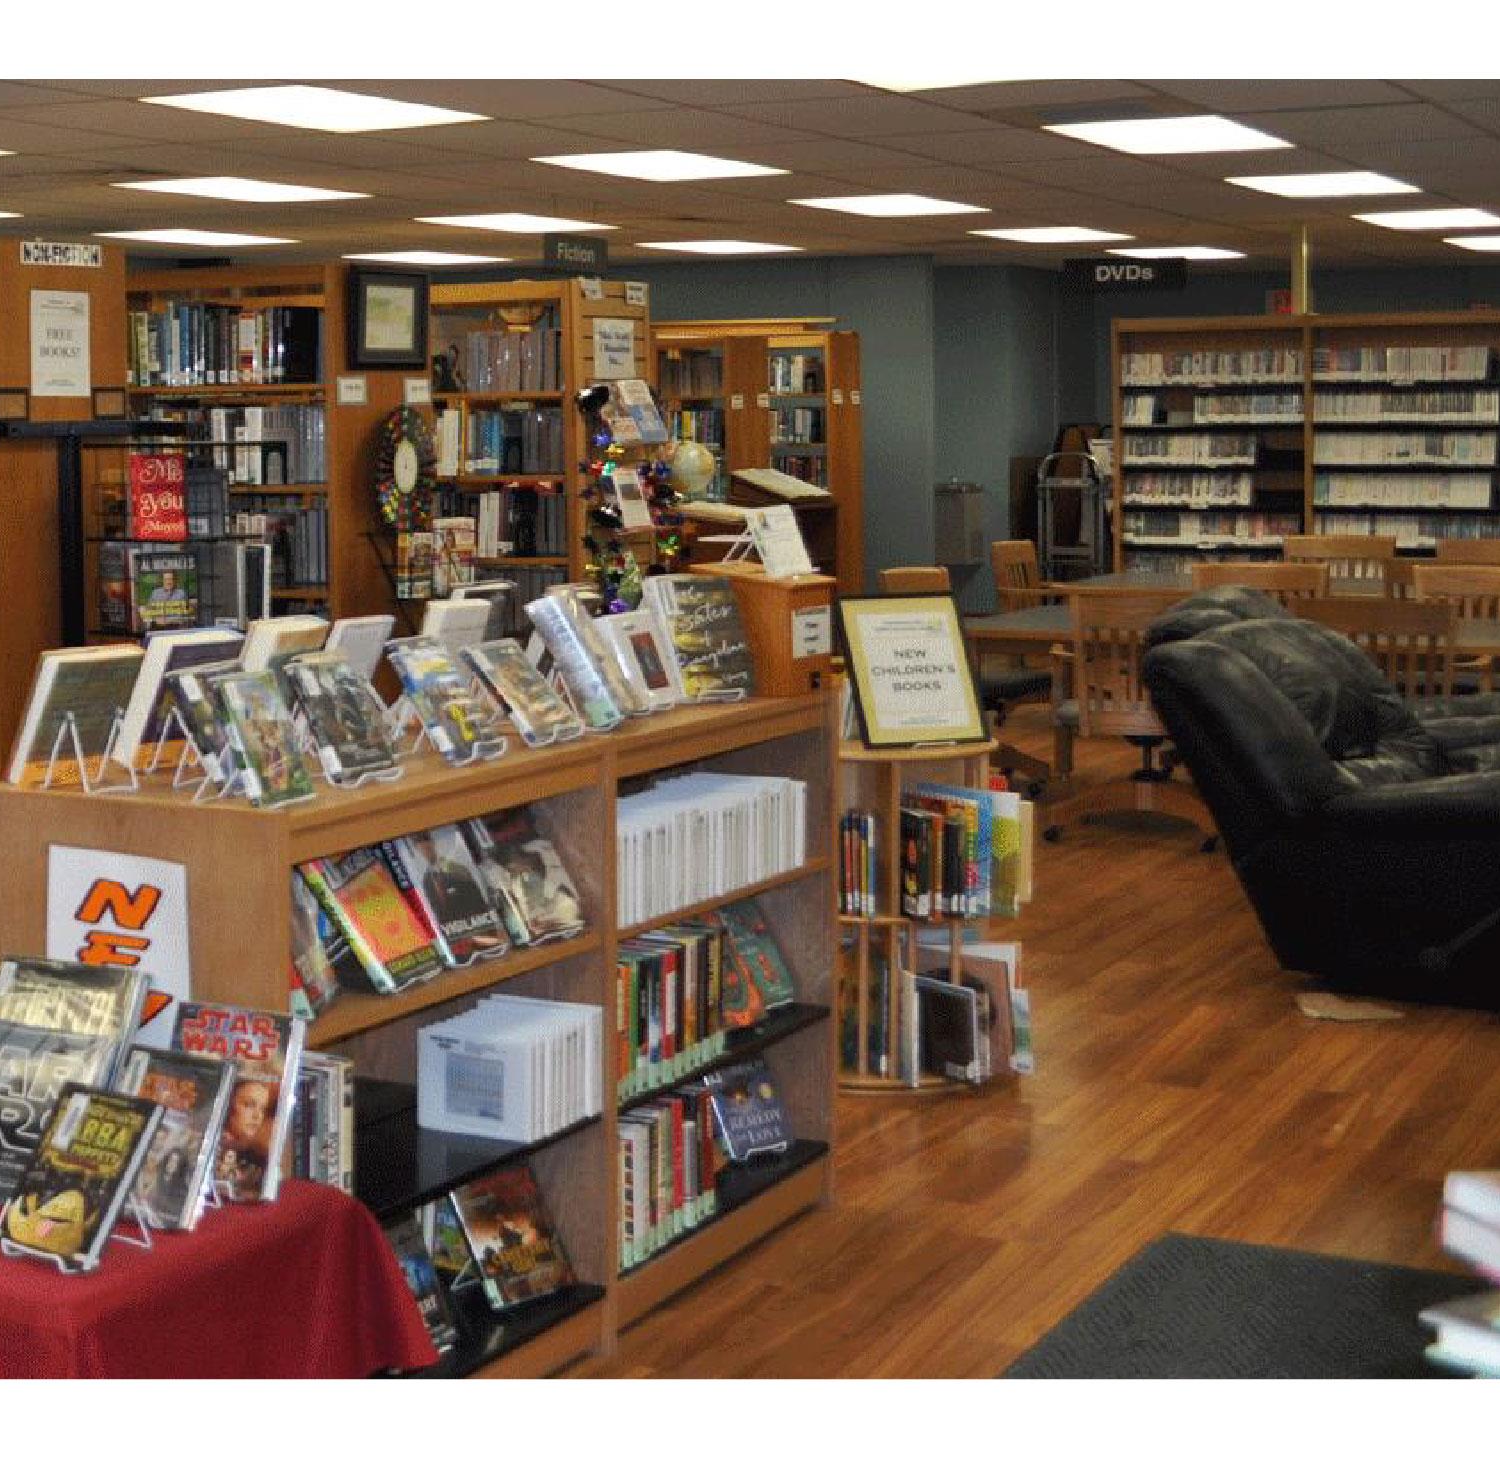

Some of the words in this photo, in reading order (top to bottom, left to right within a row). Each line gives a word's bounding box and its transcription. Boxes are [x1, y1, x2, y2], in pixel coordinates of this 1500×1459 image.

[557, 242, 595, 263] Fiction
[1095, 264, 1153, 281] DVDs
[893, 648, 927, 659] NEW
[870, 663, 956, 677] CHILDREN'S
[893, 681, 942, 691] BOOKS
[183, 1006, 281, 1038] STAR
[183, 1031, 278, 1060] WARS
